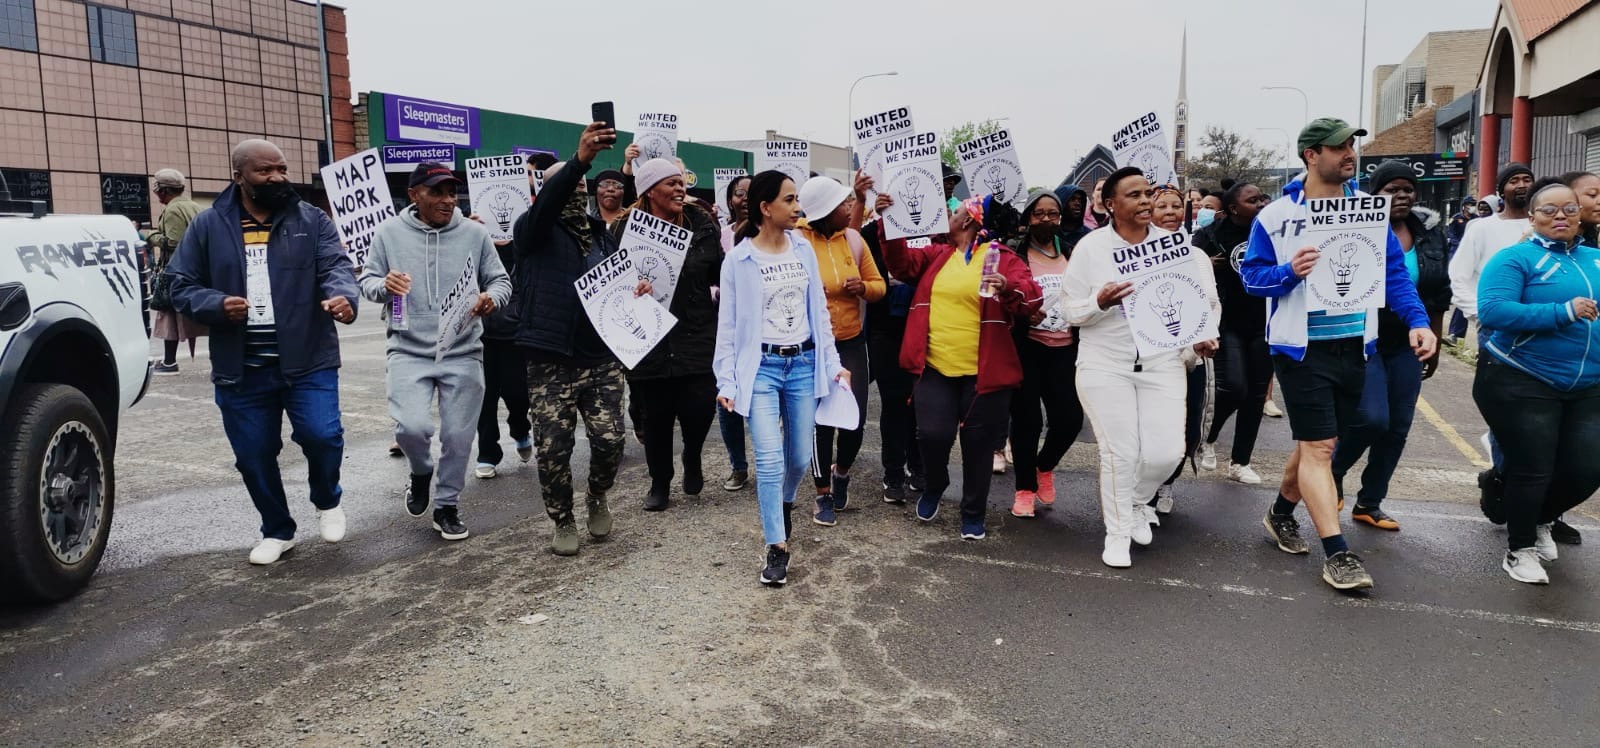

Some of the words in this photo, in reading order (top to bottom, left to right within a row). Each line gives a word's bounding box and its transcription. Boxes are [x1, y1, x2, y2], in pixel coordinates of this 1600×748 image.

[403, 105, 465, 126] Sleepmasters
[639, 113, 677, 122] UNITED
[651, 122, 677, 130] STAND
[854, 107, 908, 130] UNITED
[1113, 112, 1156, 142] UNITED
[857, 130, 872, 140] WE
[876, 119, 911, 135] STAND
[958, 130, 1008, 153] UNITED
[1114, 138, 1129, 151] WE
[1131, 122, 1160, 143] STAND
[387, 148, 451, 160] Sleepmasters
[766, 142, 808, 150] UNITED
[885, 132, 936, 153] UNITED
[962, 151, 977, 161] WE
[980, 140, 1011, 156] STAND
[468, 156, 522, 169] UNITED
[886, 156, 899, 165] WE
[902, 145, 937, 160] STAND
[335, 154, 376, 189] MAP
[471, 171, 486, 179] WE
[489, 168, 525, 178] STAND
[913, 166, 943, 197] POWERLESS
[333, 186, 380, 217] WORK
[1310, 196, 1386, 212] UNITED
[341, 213, 375, 238] WITH
[632, 210, 688, 241] UNITED
[930, 207, 943, 228] POWER
[1311, 215, 1333, 225] WE
[1338, 212, 1385, 224] STAND
[630, 222, 646, 236] WE
[649, 231, 685, 251] STAND
[1113, 232, 1184, 263] UNITED
[16, 240, 137, 279] RANGER
[1118, 262, 1139, 275] WE
[1144, 246, 1190, 268] STAND
[1351, 232, 1384, 268] POWERLESS
[577, 248, 628, 290] UNITED
[583, 285, 599, 300] WE
[600, 260, 632, 287] STAND
[760, 263, 803, 274] UNITED
[1129, 273, 1161, 312] HARRISMITH
[1162, 272, 1206, 299] POWERLESS
[1344, 299, 1361, 308] OUR
[1360, 279, 1381, 301] POWER
[1157, 341, 1178, 349] BACK
[1179, 335, 1194, 346] OUR
[1194, 311, 1209, 337] POWER
